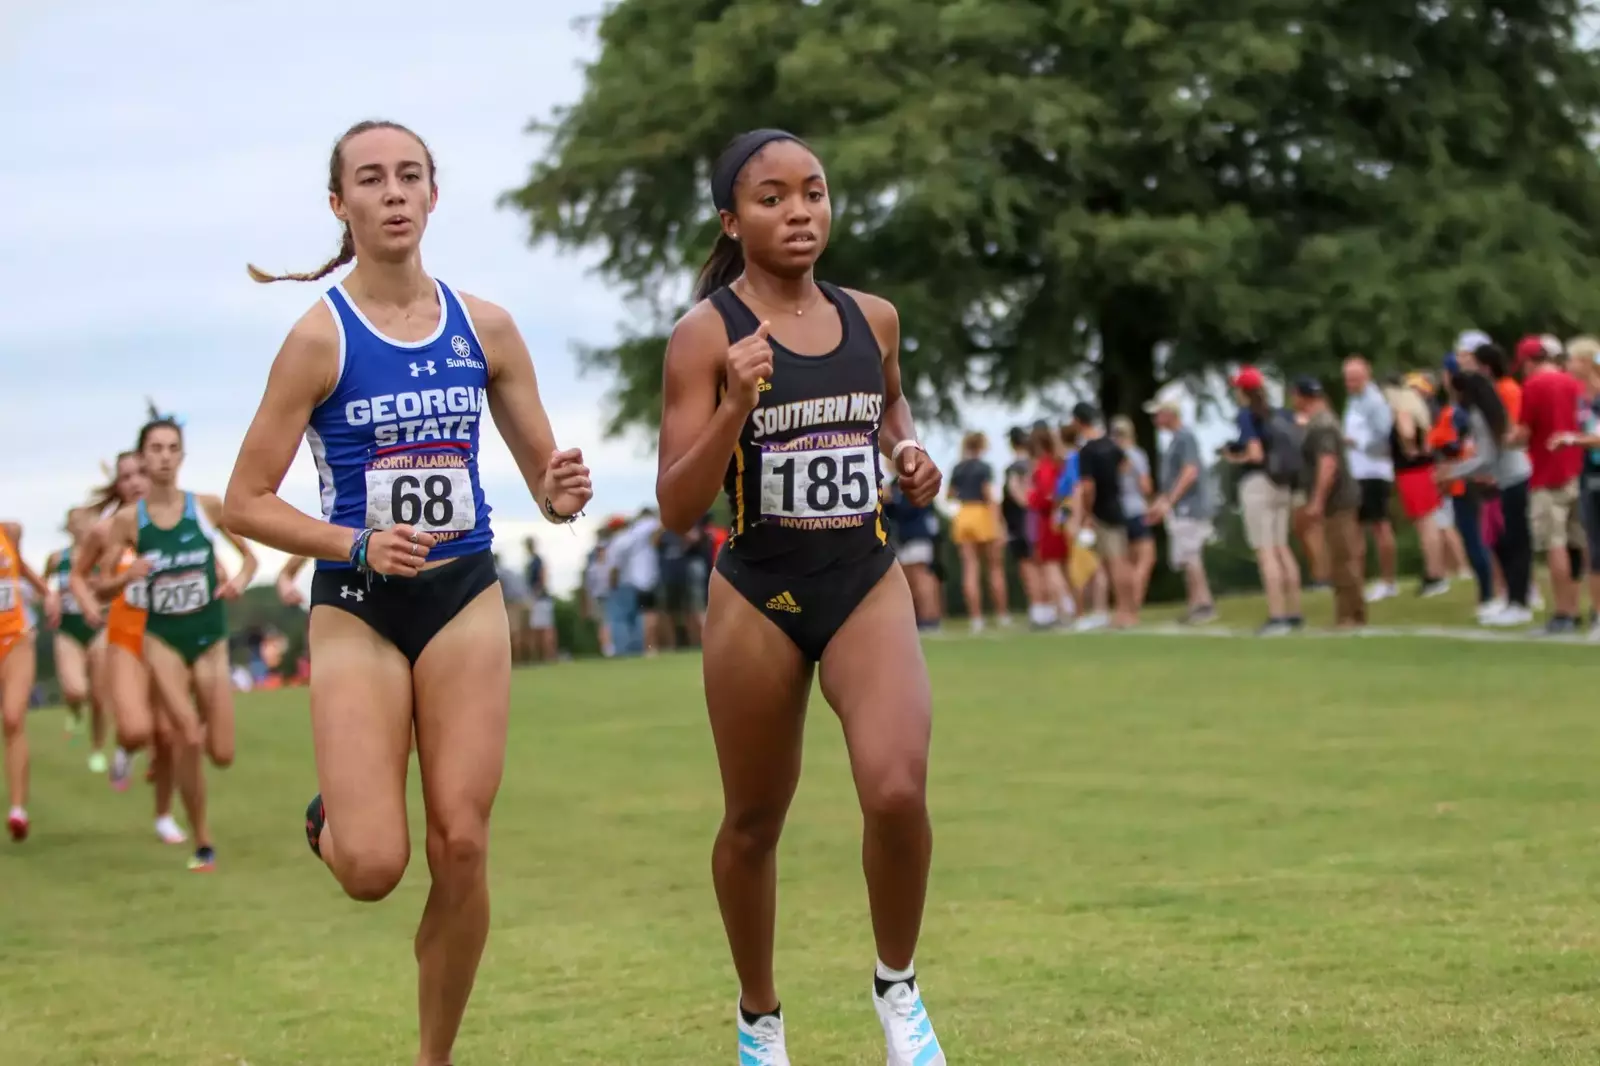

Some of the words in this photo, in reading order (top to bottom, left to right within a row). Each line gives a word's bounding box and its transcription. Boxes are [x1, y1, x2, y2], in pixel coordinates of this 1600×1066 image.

[446, 358, 466, 368] SUN
[752, 395, 848, 438] SOUTHERN
[848, 392, 882, 422] MISS
[374, 415, 477, 447] STATE
[816, 432, 869, 449] ALABAMA
[372, 455, 413, 469] NORTH
[416, 455, 465, 468] ALABAMA
[772, 454, 869, 512] 185
[391, 474, 453, 527] 68
[780, 515, 864, 530] INVITATIONAL
[159, 581, 205, 614] 205
[766, 602, 802, 613] adidas
